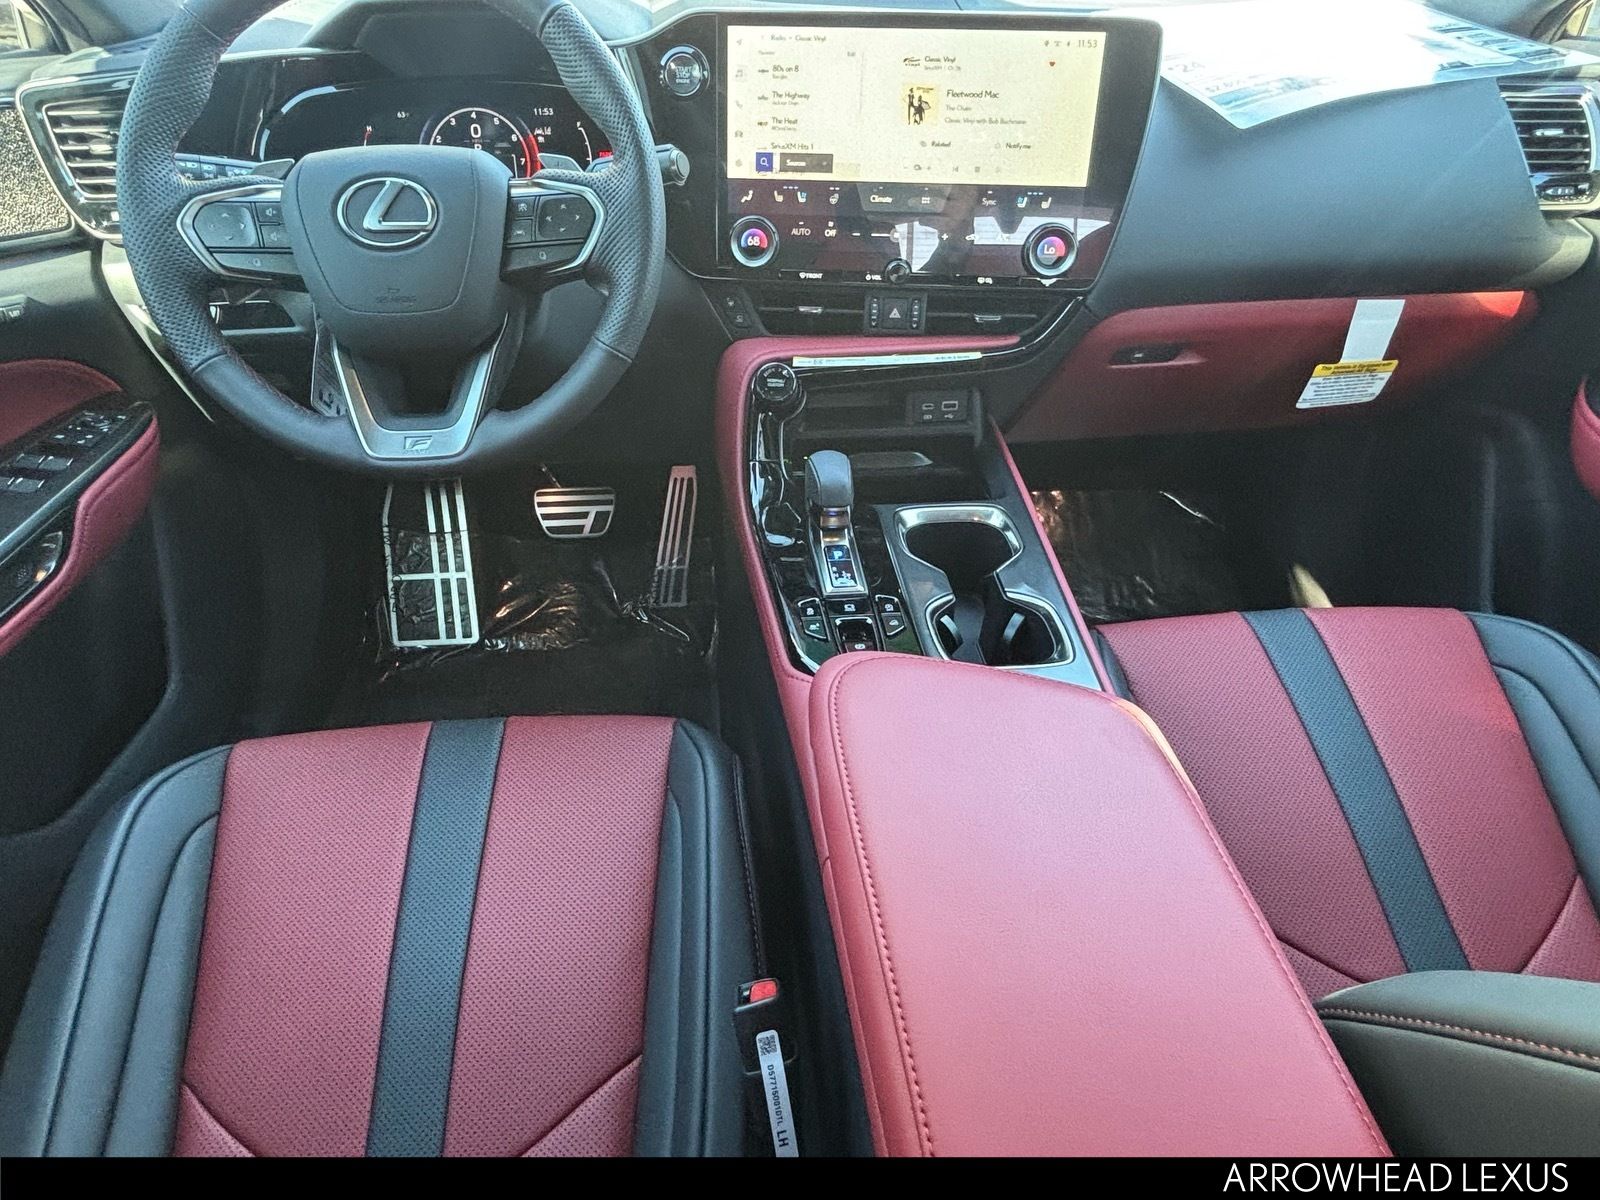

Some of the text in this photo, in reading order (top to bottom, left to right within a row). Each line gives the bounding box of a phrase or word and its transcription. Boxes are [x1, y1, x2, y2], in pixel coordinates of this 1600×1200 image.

[946, 89, 1000, 99] Fleetwood Mac
[534, 108, 554, 116] 11:53
[450, 118, 456, 126] 3
[494, 117, 500, 126] 5
[470, 123, 482, 139] 0
[436, 135, 442, 144] 2
[511, 134, 518, 142] 6
[520, 158, 525, 166] 7
[981, 197, 997, 206] Sync
[791, 227, 812, 236] AUTO
[824, 229, 837, 237] Off
[747, 235, 761, 247] 68
[1043, 244, 1056, 255] Lo
[833, 550, 843, 560] P
[776, 1129, 789, 1148] LH
